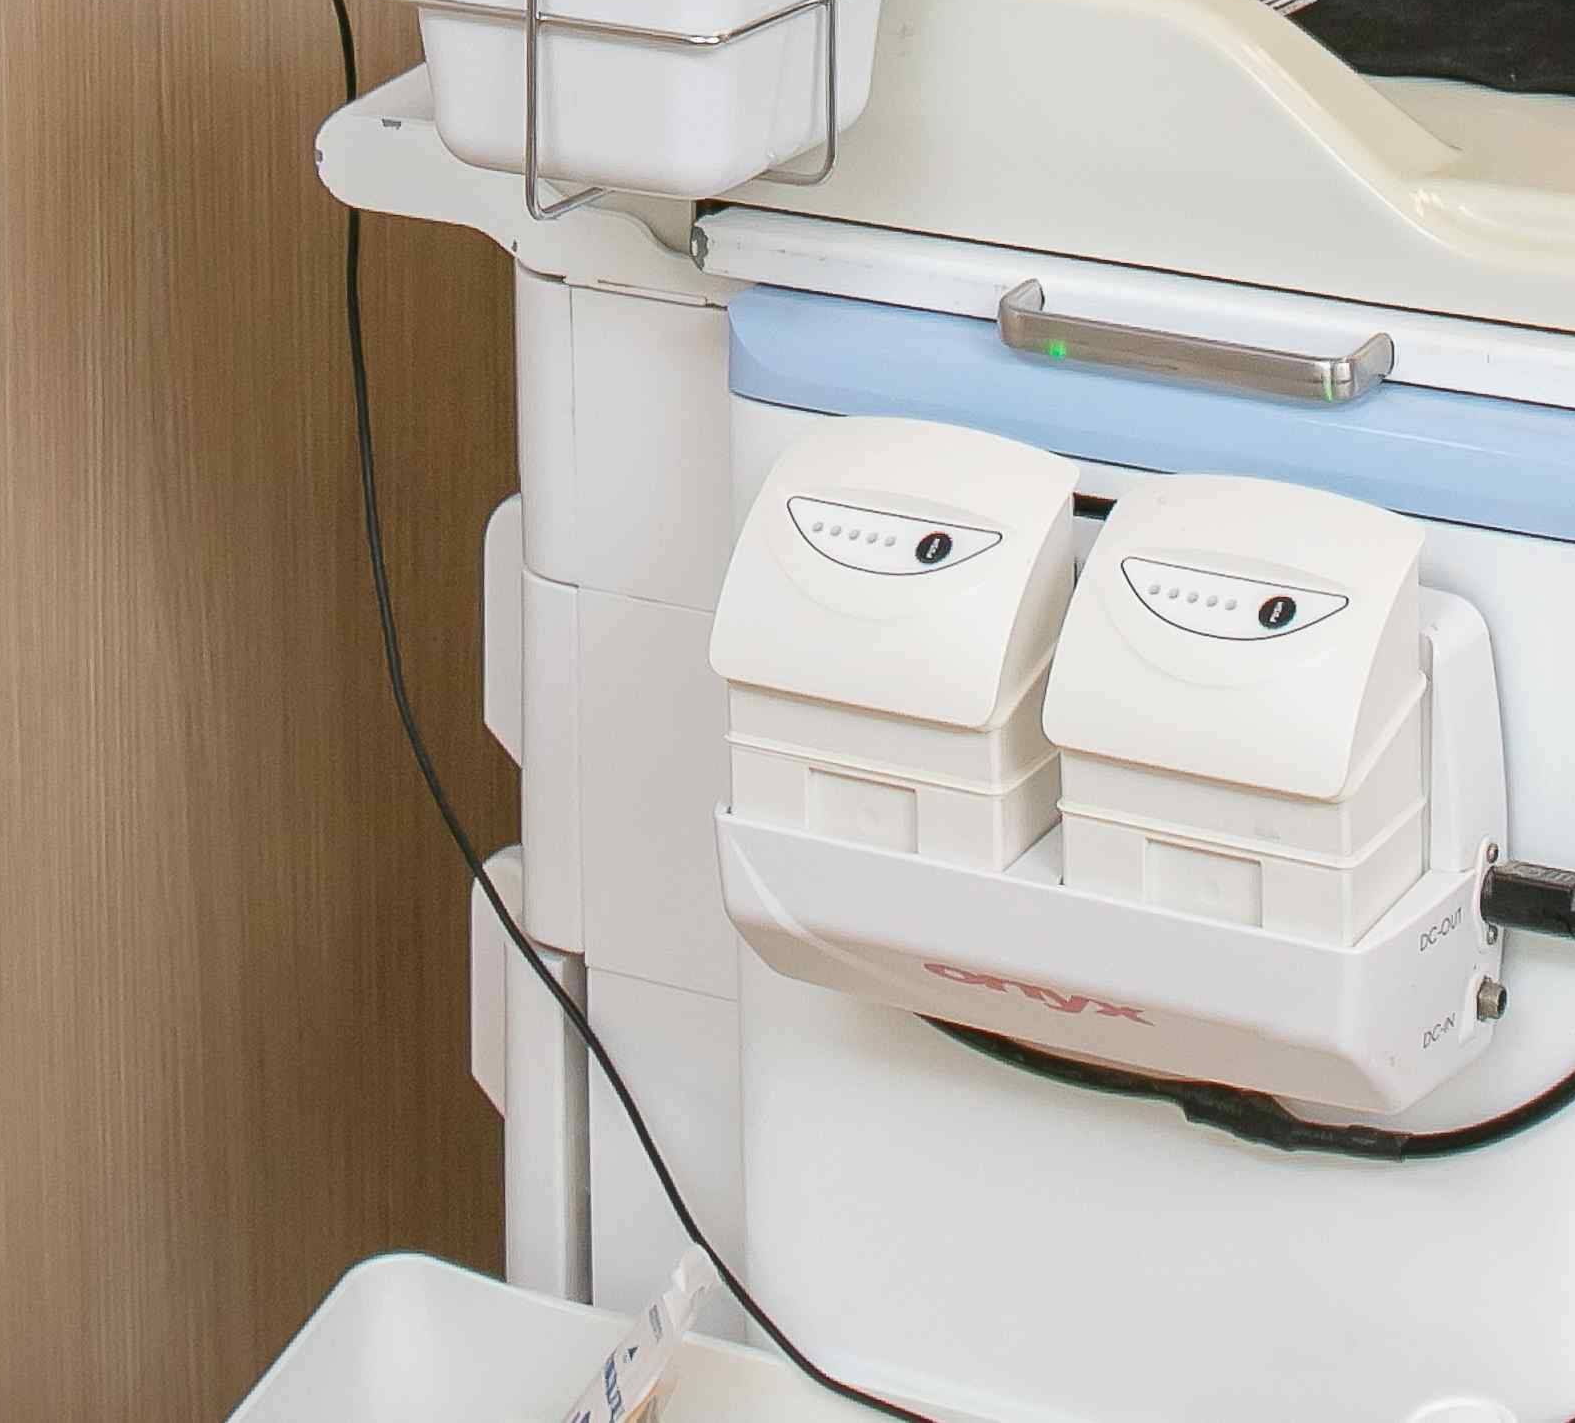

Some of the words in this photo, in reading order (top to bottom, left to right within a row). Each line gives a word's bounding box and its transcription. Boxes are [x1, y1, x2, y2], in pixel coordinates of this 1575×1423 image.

[1419, 907, 1463, 952] DC-OUT
[923, 962, 1157, 1027] onyx
[1422, 1012, 1457, 1049] DC-IN
